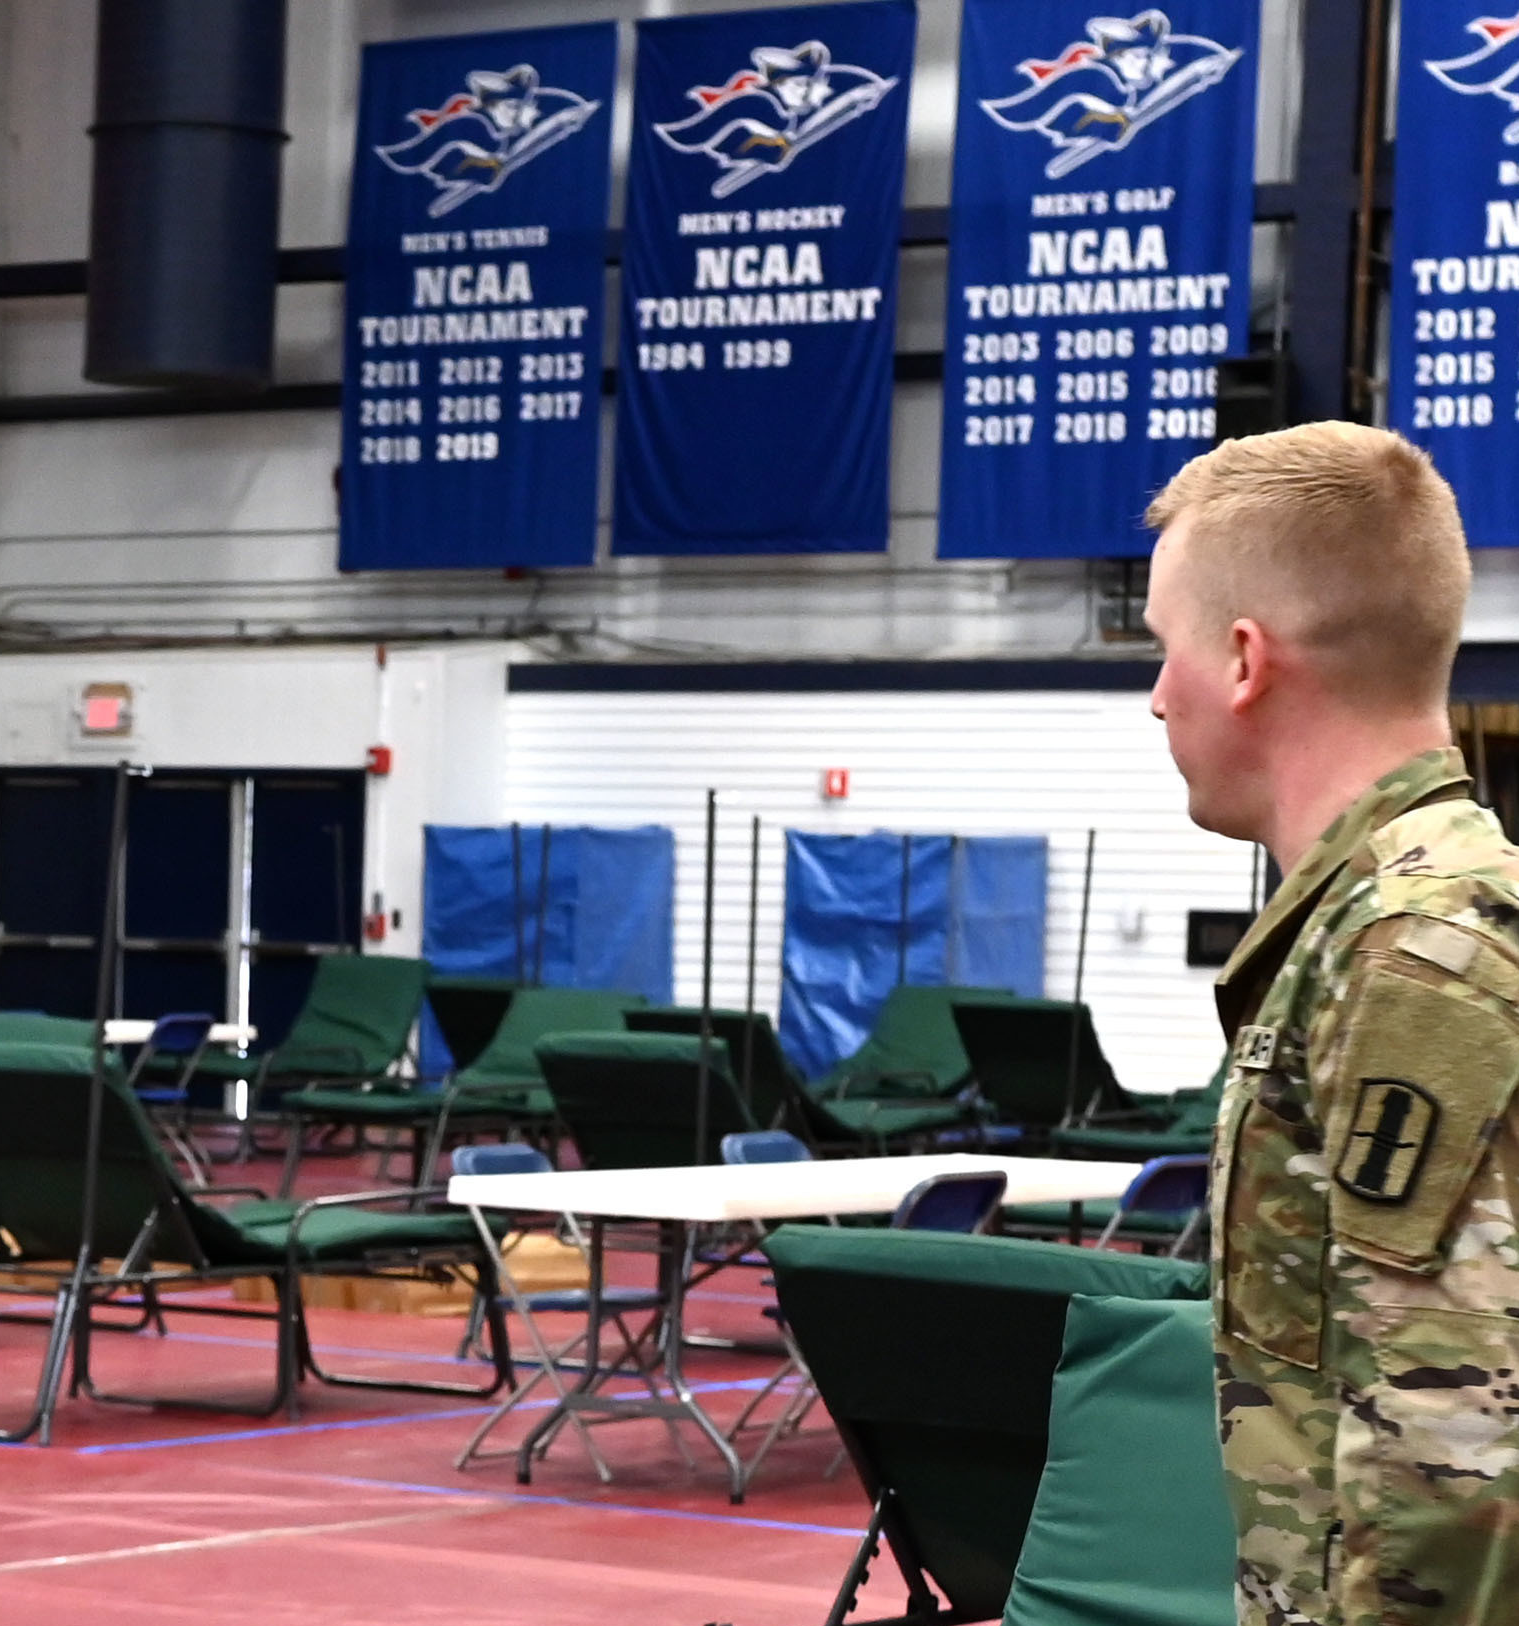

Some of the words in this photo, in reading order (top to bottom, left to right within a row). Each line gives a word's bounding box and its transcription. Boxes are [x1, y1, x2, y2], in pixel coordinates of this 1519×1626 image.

[1031, 192, 1108, 217] MEN'S
[1115, 187, 1175, 212] GOLF
[679, 211, 751, 235] MEN'S
[756, 205, 845, 231] HOCKEY
[403, 232, 466, 253] MEN'S
[472, 227, 548, 249] TENNIS
[1028, 225, 1168, 276] NCAA
[695, 243, 823, 290] NCAA
[414, 262, 532, 307] NCAA
[964, 274, 1230, 319] TOURNAMENT
[636, 287, 882, 329] TOURNAMENT
[1415, 307, 1496, 342] 2012
[360, 307, 588, 347] TOURNAMENT
[963, 331, 1040, 364] 2003
[1055, 328, 1134, 360] 2006
[1150, 323, 1229, 356] 2009
[361, 360, 419, 388] 2011
[439, 356, 502, 385] 2012
[519, 352, 584, 381] 2013
[723, 339, 791, 368] 1999
[1415, 351, 1495, 386] 2015
[965, 374, 1036, 406] 2014
[1057, 370, 1128, 402] 2015
[361, 398, 421, 426] 2014
[519, 391, 582, 420] 2017
[1413, 395, 1493, 429] 2018
[436, 431, 499, 461] 2019
[965, 414, 1034, 446] 2017
[1054, 412, 1126, 443] 2018
